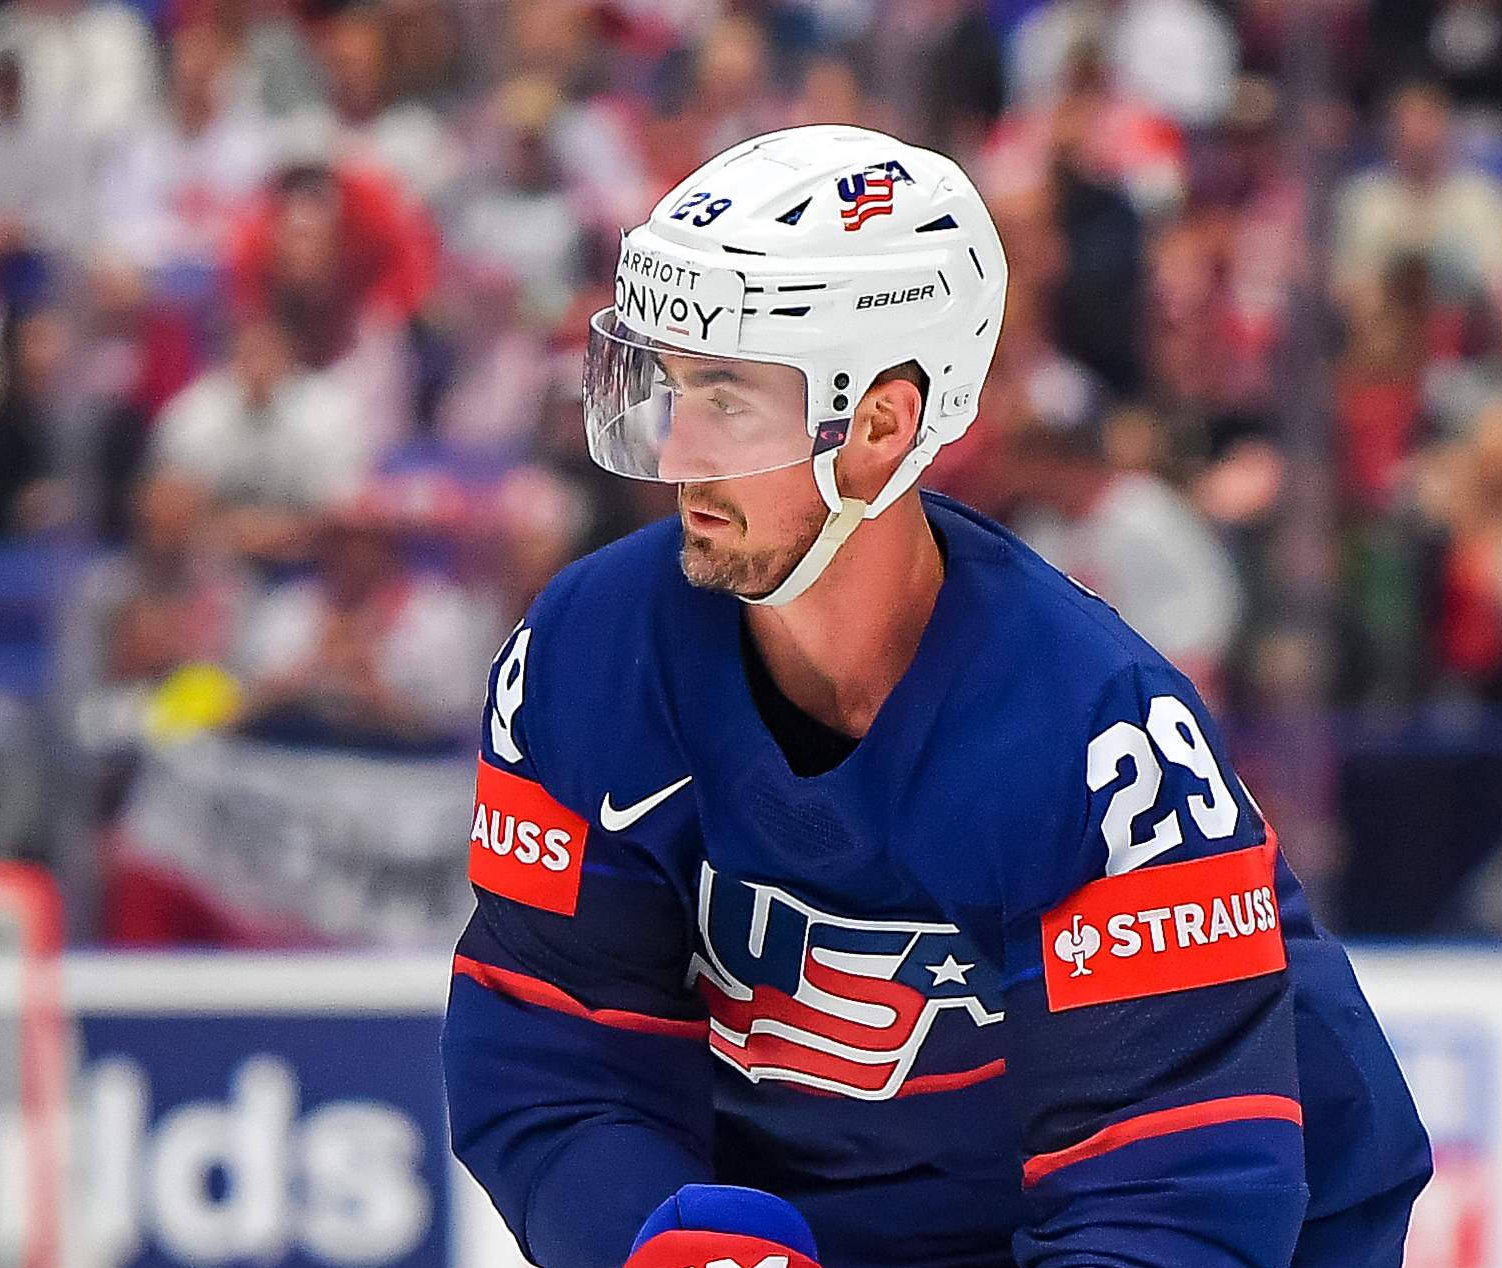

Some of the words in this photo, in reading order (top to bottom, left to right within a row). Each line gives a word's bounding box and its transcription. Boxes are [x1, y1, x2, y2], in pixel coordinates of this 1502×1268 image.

[669, 192, 733, 228] 29
[835, 160, 916, 232] USA
[622, 249, 701, 291] ARRIOTT
[485, 620, 533, 765] 9
[1085, 694, 1240, 879] 29
[470, 802, 572, 872] AUSS
[1106, 885, 1277, 958] STRAUSS
[685, 859, 1006, 1101] USA
